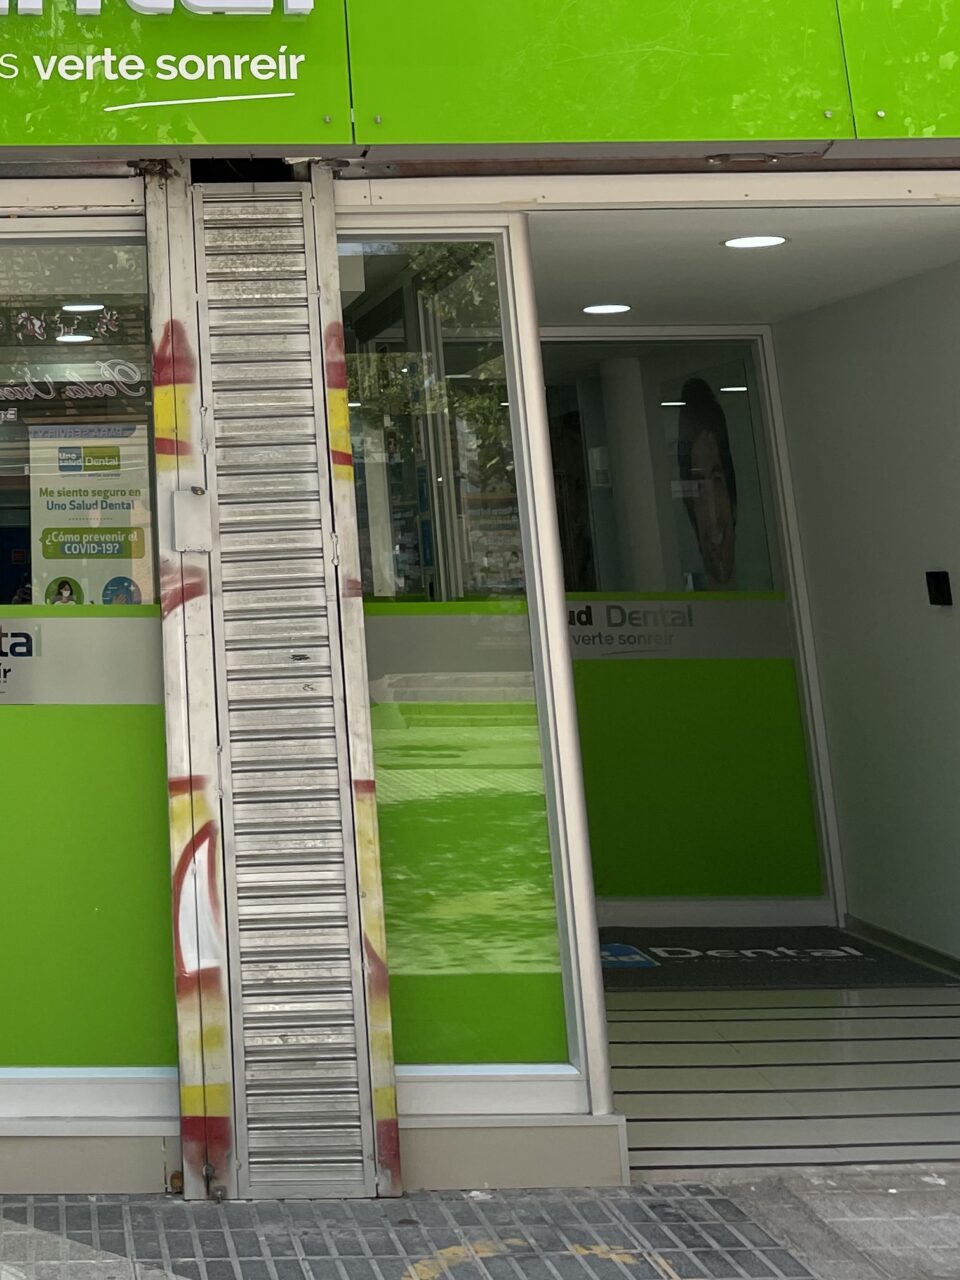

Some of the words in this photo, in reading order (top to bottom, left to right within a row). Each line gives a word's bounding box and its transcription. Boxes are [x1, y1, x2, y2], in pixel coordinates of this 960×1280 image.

[33, 47, 145, 81] verte
[155, 45, 306, 81] sonreír
[39, 487, 55, 497] Me
[57, 486, 90, 497] siento
[91, 488, 127, 500] seguro
[128, 489, 141, 497] en
[46, 500, 67, 511] Uno
[69, 500, 99, 510] Salud
[101, 500, 135, 510] Dental
[45, 531, 81, 545] ¿Cómo
[82, 530, 126, 544] prevenir
[128, 531, 138, 541] el
[64, 543, 120, 554] COVID-19?
[605, 604, 694, 628] Dental
[572, 631, 615, 646] verte
[648, 946, 864, 958] Dental
